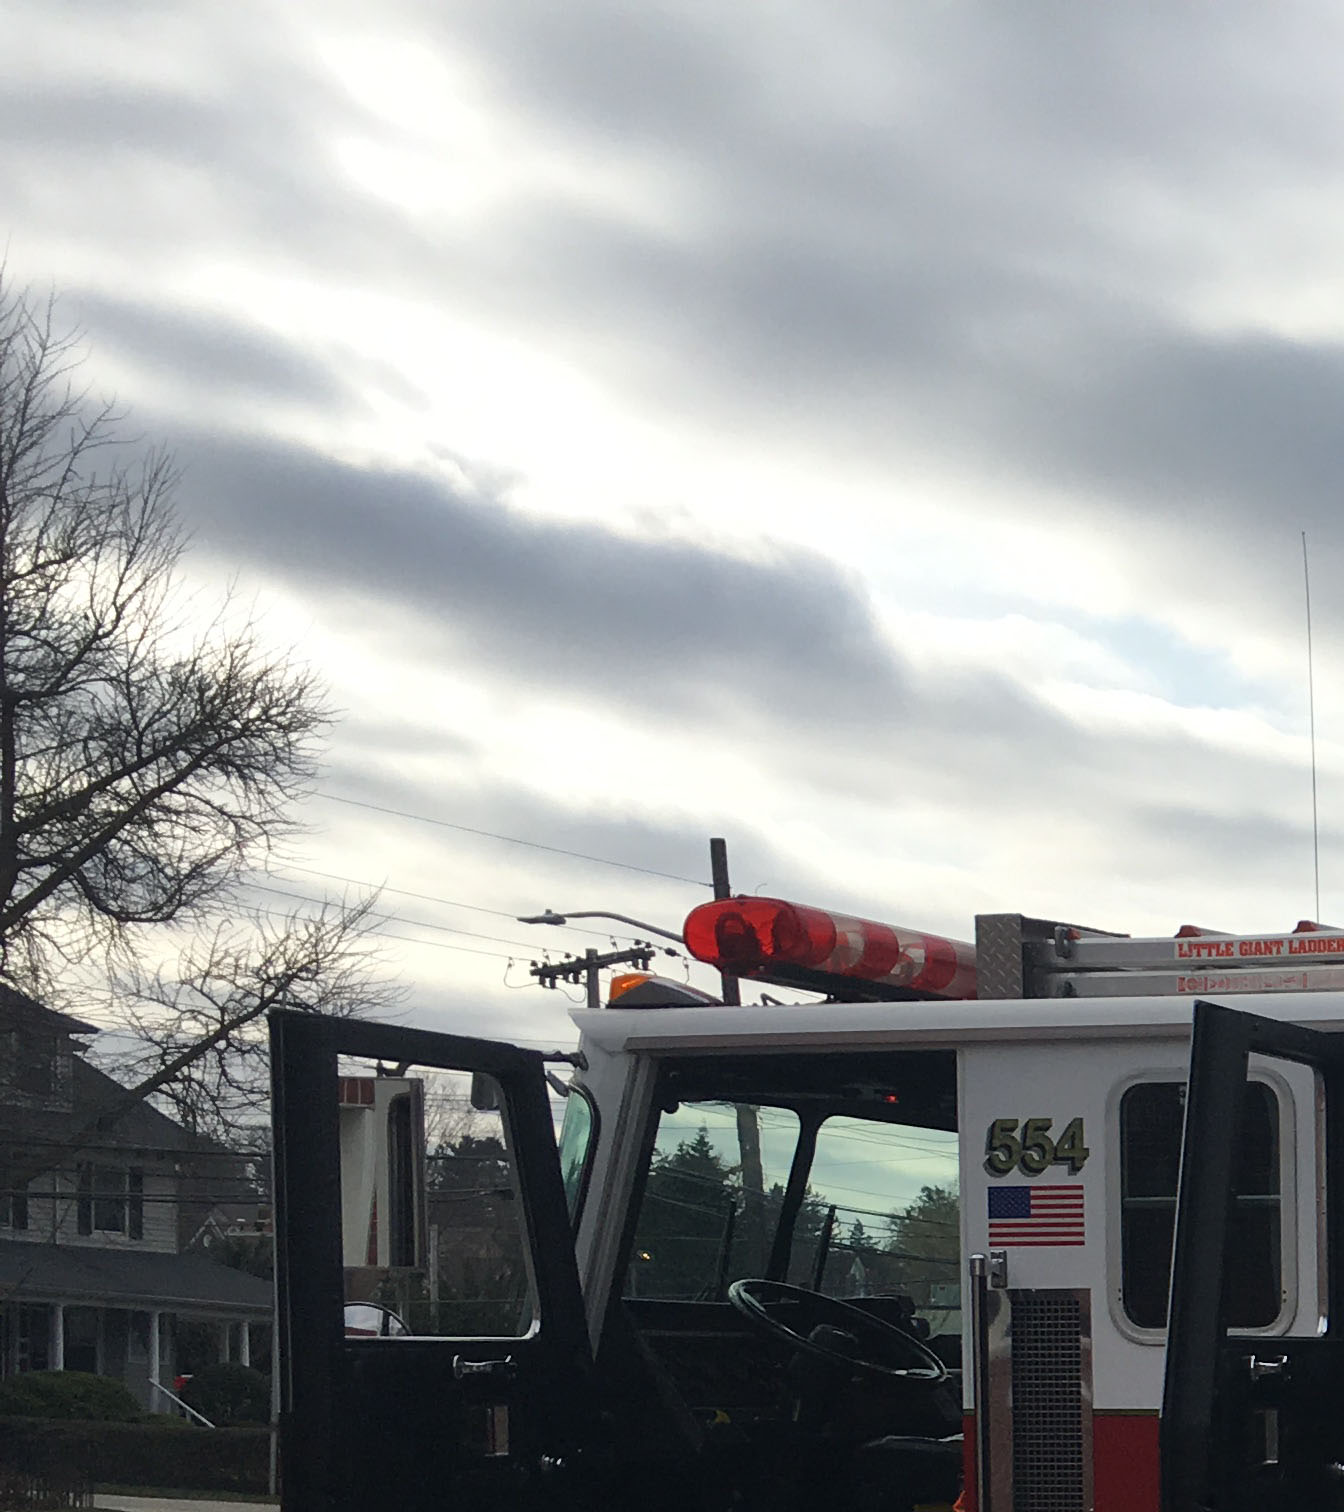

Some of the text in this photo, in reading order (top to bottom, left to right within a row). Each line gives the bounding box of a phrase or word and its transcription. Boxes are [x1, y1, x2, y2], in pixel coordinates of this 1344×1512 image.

[1178, 941, 1234, 958] LITTLE
[1239, 940, 1284, 957] GIANT
[983, 1117, 1089, 1178] 554
